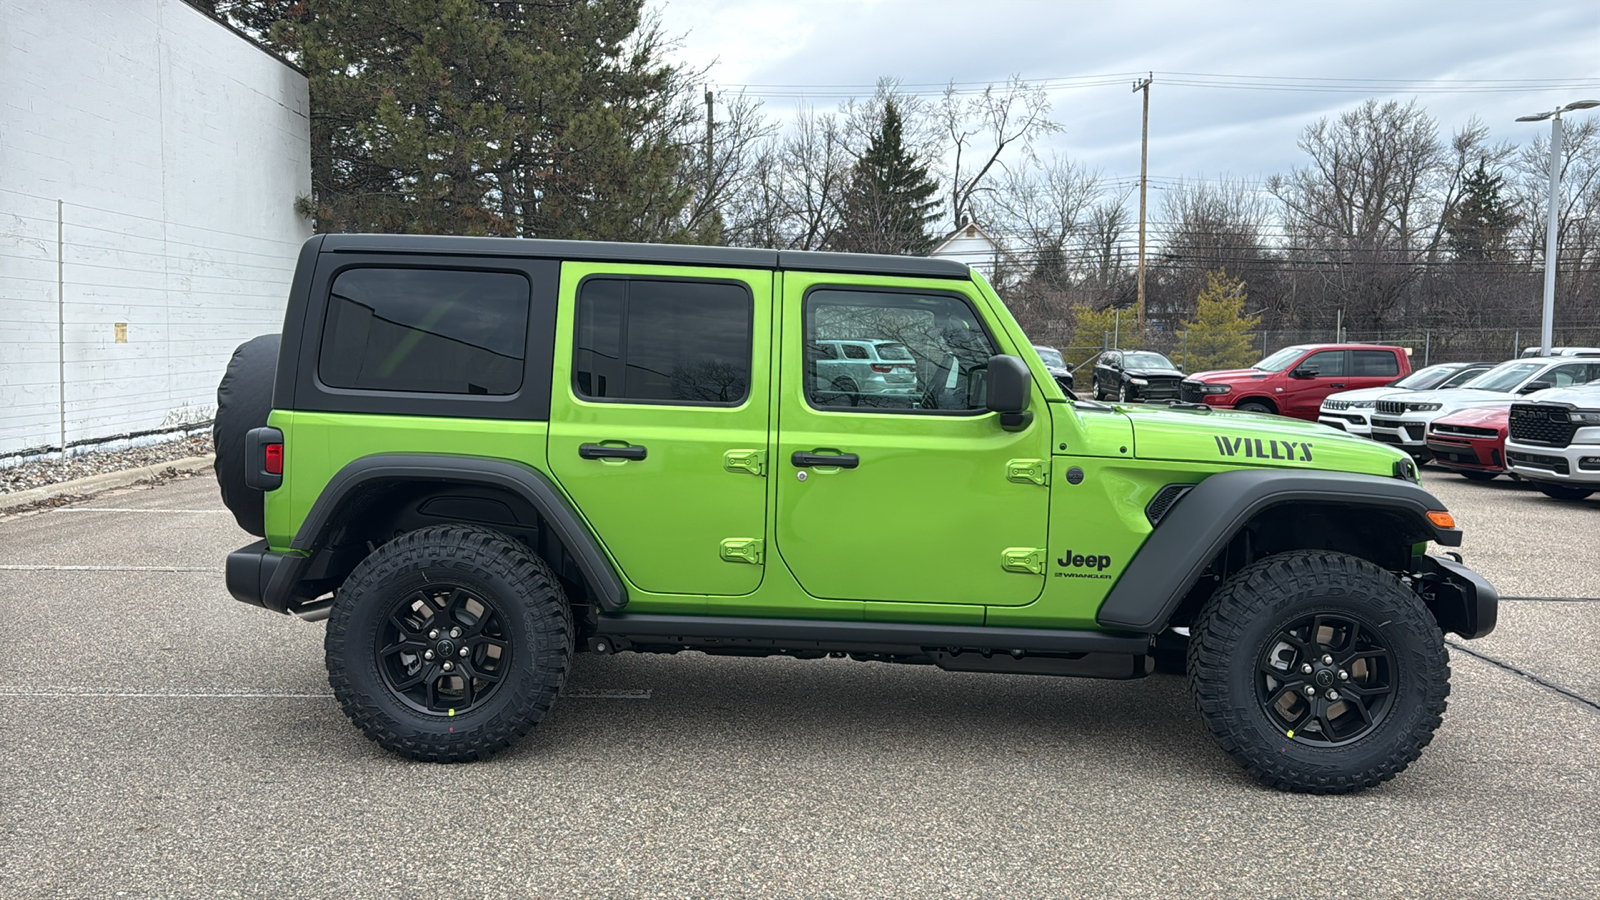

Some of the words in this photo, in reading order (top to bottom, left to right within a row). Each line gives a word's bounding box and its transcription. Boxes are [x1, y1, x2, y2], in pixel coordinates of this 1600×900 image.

[1214, 435, 1313, 462] WILLYS
[1057, 549, 1111, 571] Jeep
[1063, 572, 1112, 580] WRANGLER
